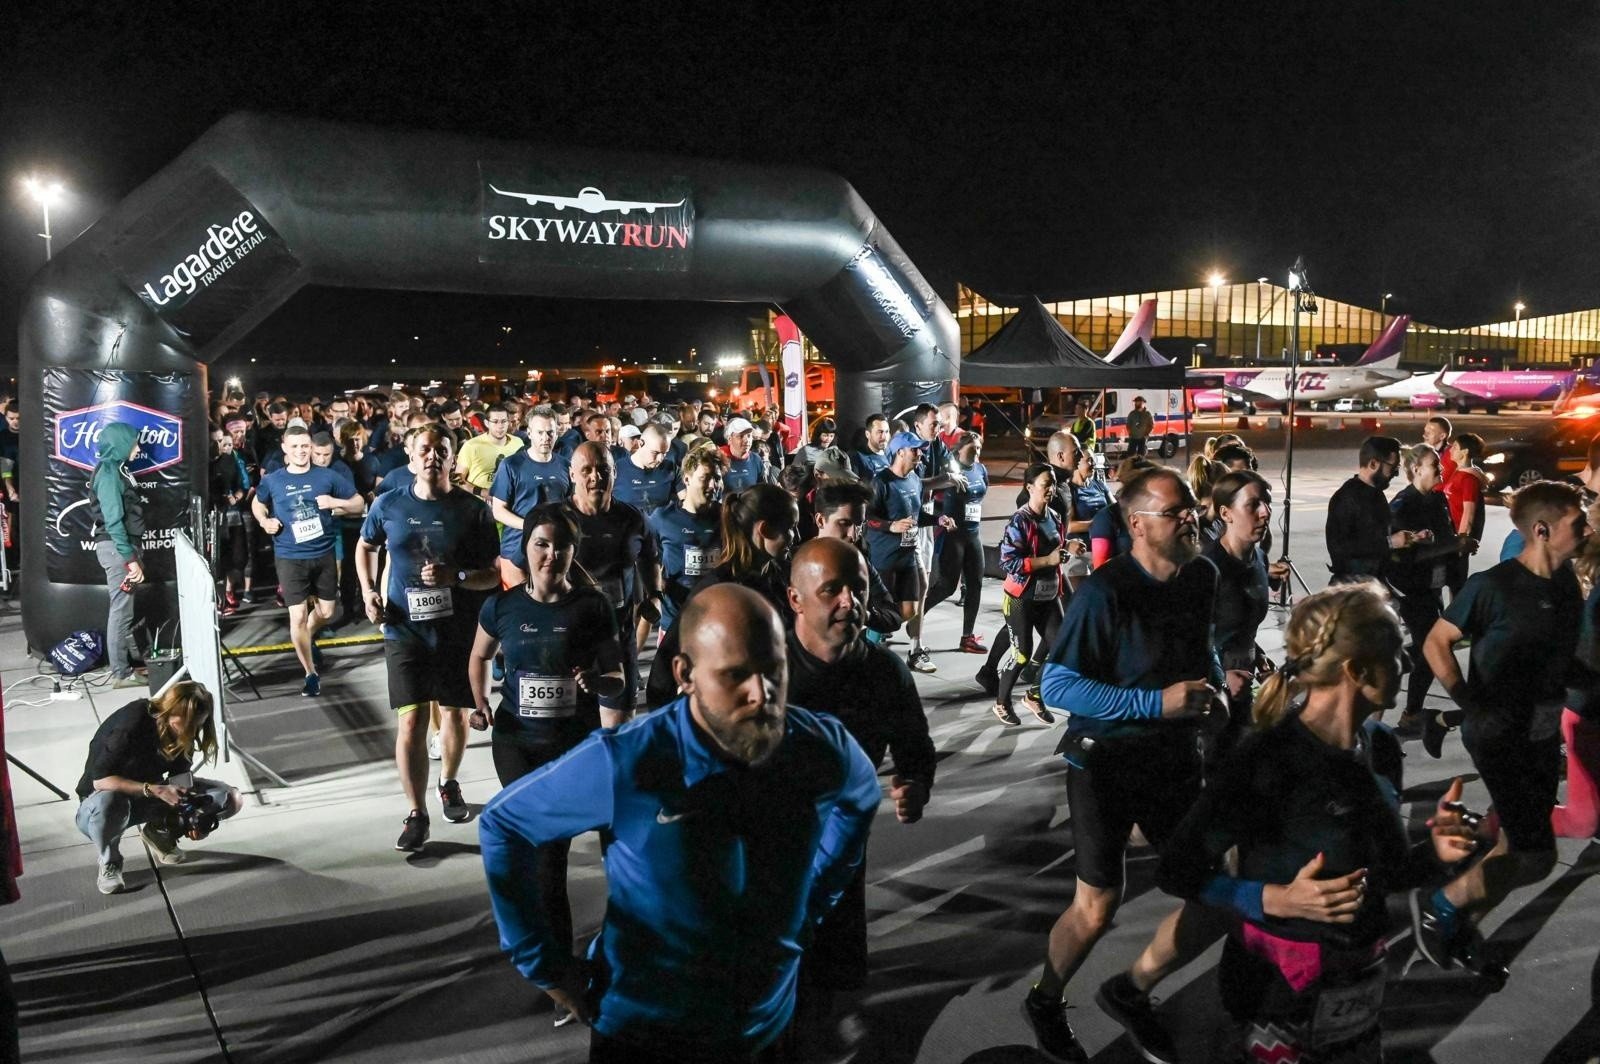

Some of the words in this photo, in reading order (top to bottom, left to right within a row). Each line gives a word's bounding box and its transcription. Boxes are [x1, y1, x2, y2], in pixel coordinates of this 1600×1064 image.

[488, 215, 689, 248] SKYWAYRUN
[144, 210, 258, 305] Lagardère
[200, 255, 236, 287] TRAVEL
[234, 230, 266, 259] RETAIL
[871, 288, 895, 315] TRAVEL
[890, 313, 912, 338] RETAIL
[299, 523, 317, 534] 1026
[416, 595, 442, 607] 1806
[528, 686, 564, 699] 3659
